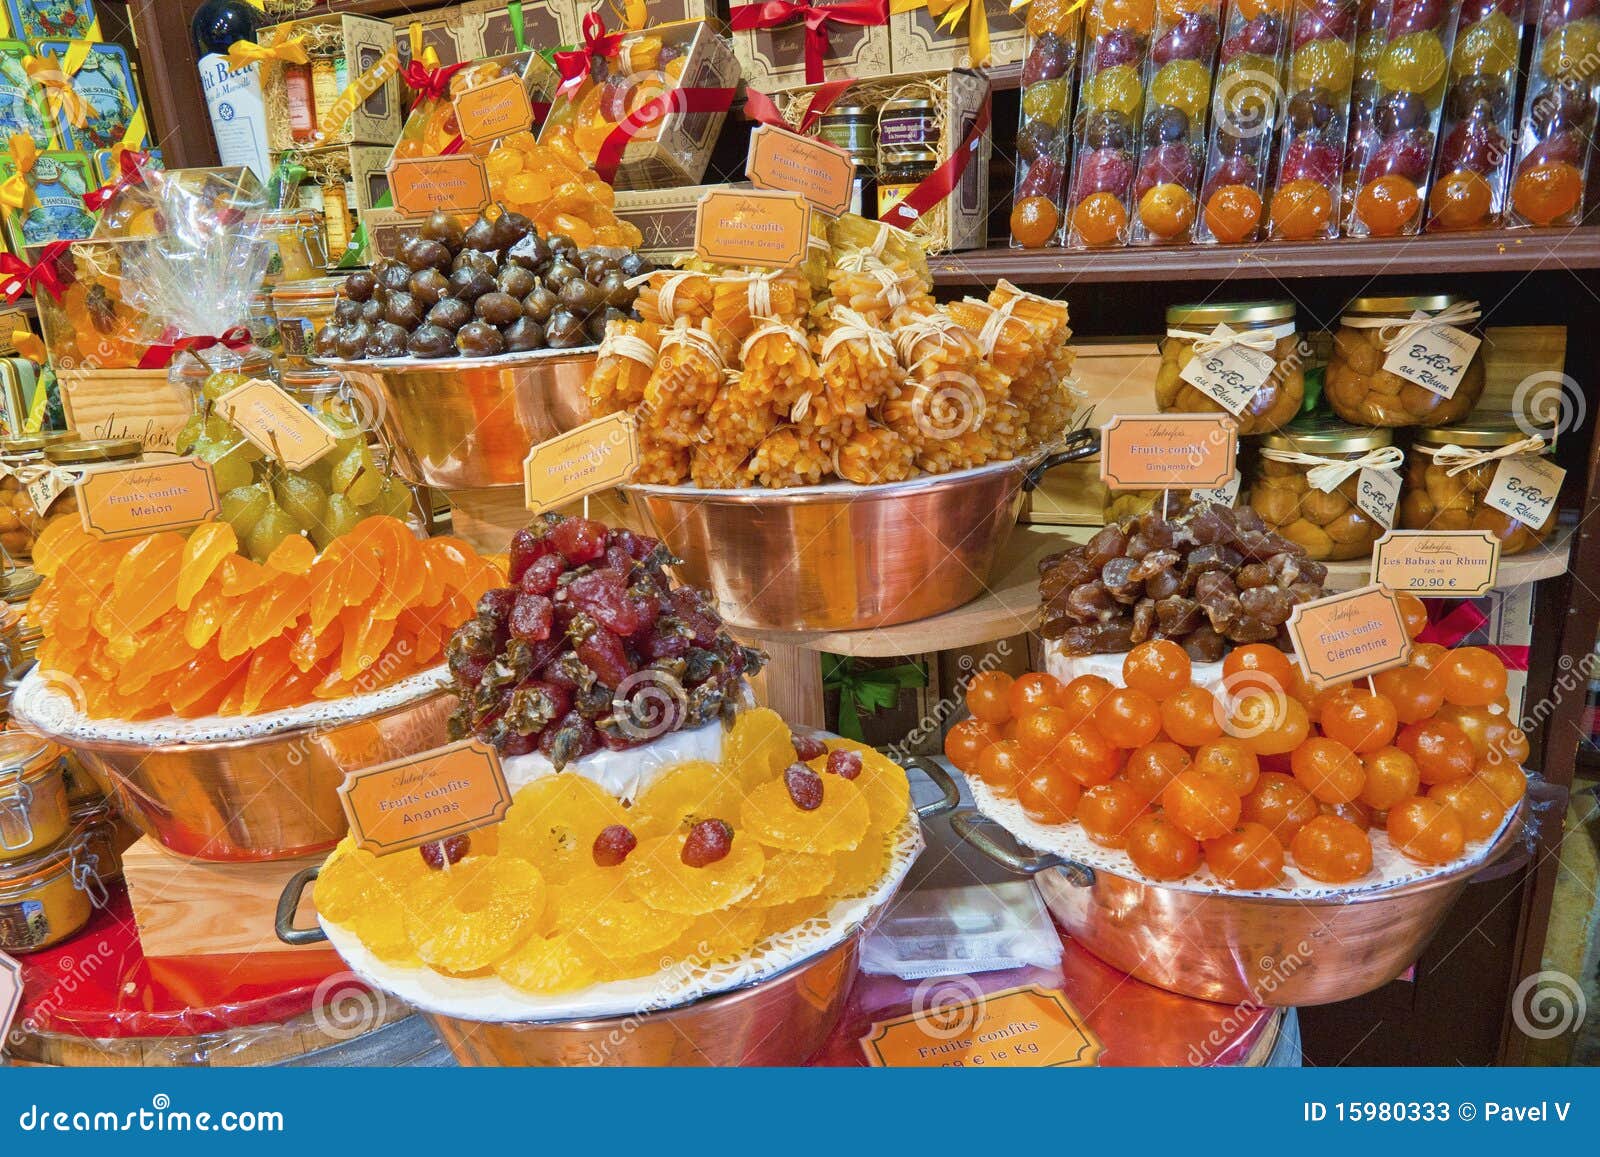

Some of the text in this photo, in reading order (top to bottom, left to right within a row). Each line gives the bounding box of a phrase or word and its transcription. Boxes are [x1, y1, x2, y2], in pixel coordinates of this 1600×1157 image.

[773, 152, 832, 181] Fruits confits
[427, 193, 455, 203] Figue
[720, 218, 784, 233] Fruits confits
[757, 239, 785, 250] Orange
[1408, 344, 1463, 376] BABA
[1205, 357, 1256, 395] BABA
[1399, 365, 1450, 392] au Rhum
[1194, 376, 1239, 409] au Rhum
[1130, 444, 1206, 454] Fruits confits
[547, 459, 575, 476] Fruits
[563, 466, 596, 484] Fraise
[1146, 463, 1195, 471] Gingembre
[109, 486, 189, 505] Fruits confits
[1362, 480, 1394, 513] BABA
[1506, 476, 1553, 507] BABA
[131, 505, 173, 518] Melon
[1498, 498, 1541, 523] au Rhum
[1383, 557, 1401, 565] Les
[1405, 557, 1436, 565] Babas
[1456, 557, 1488, 565] Rhum
[1410, 577, 1457, 587] 20,90 €
[1320, 620, 1383, 645] Fruits confits
[379, 779, 471, 812] Fruits confits
[402, 801, 460, 825] Ananas
[918, 1020, 1039, 1058] Fruits confits
[973, 1055, 985, 1065] €
[990, 1050, 1008, 1061] le
[1014, 1042, 1039, 1056] Kg
